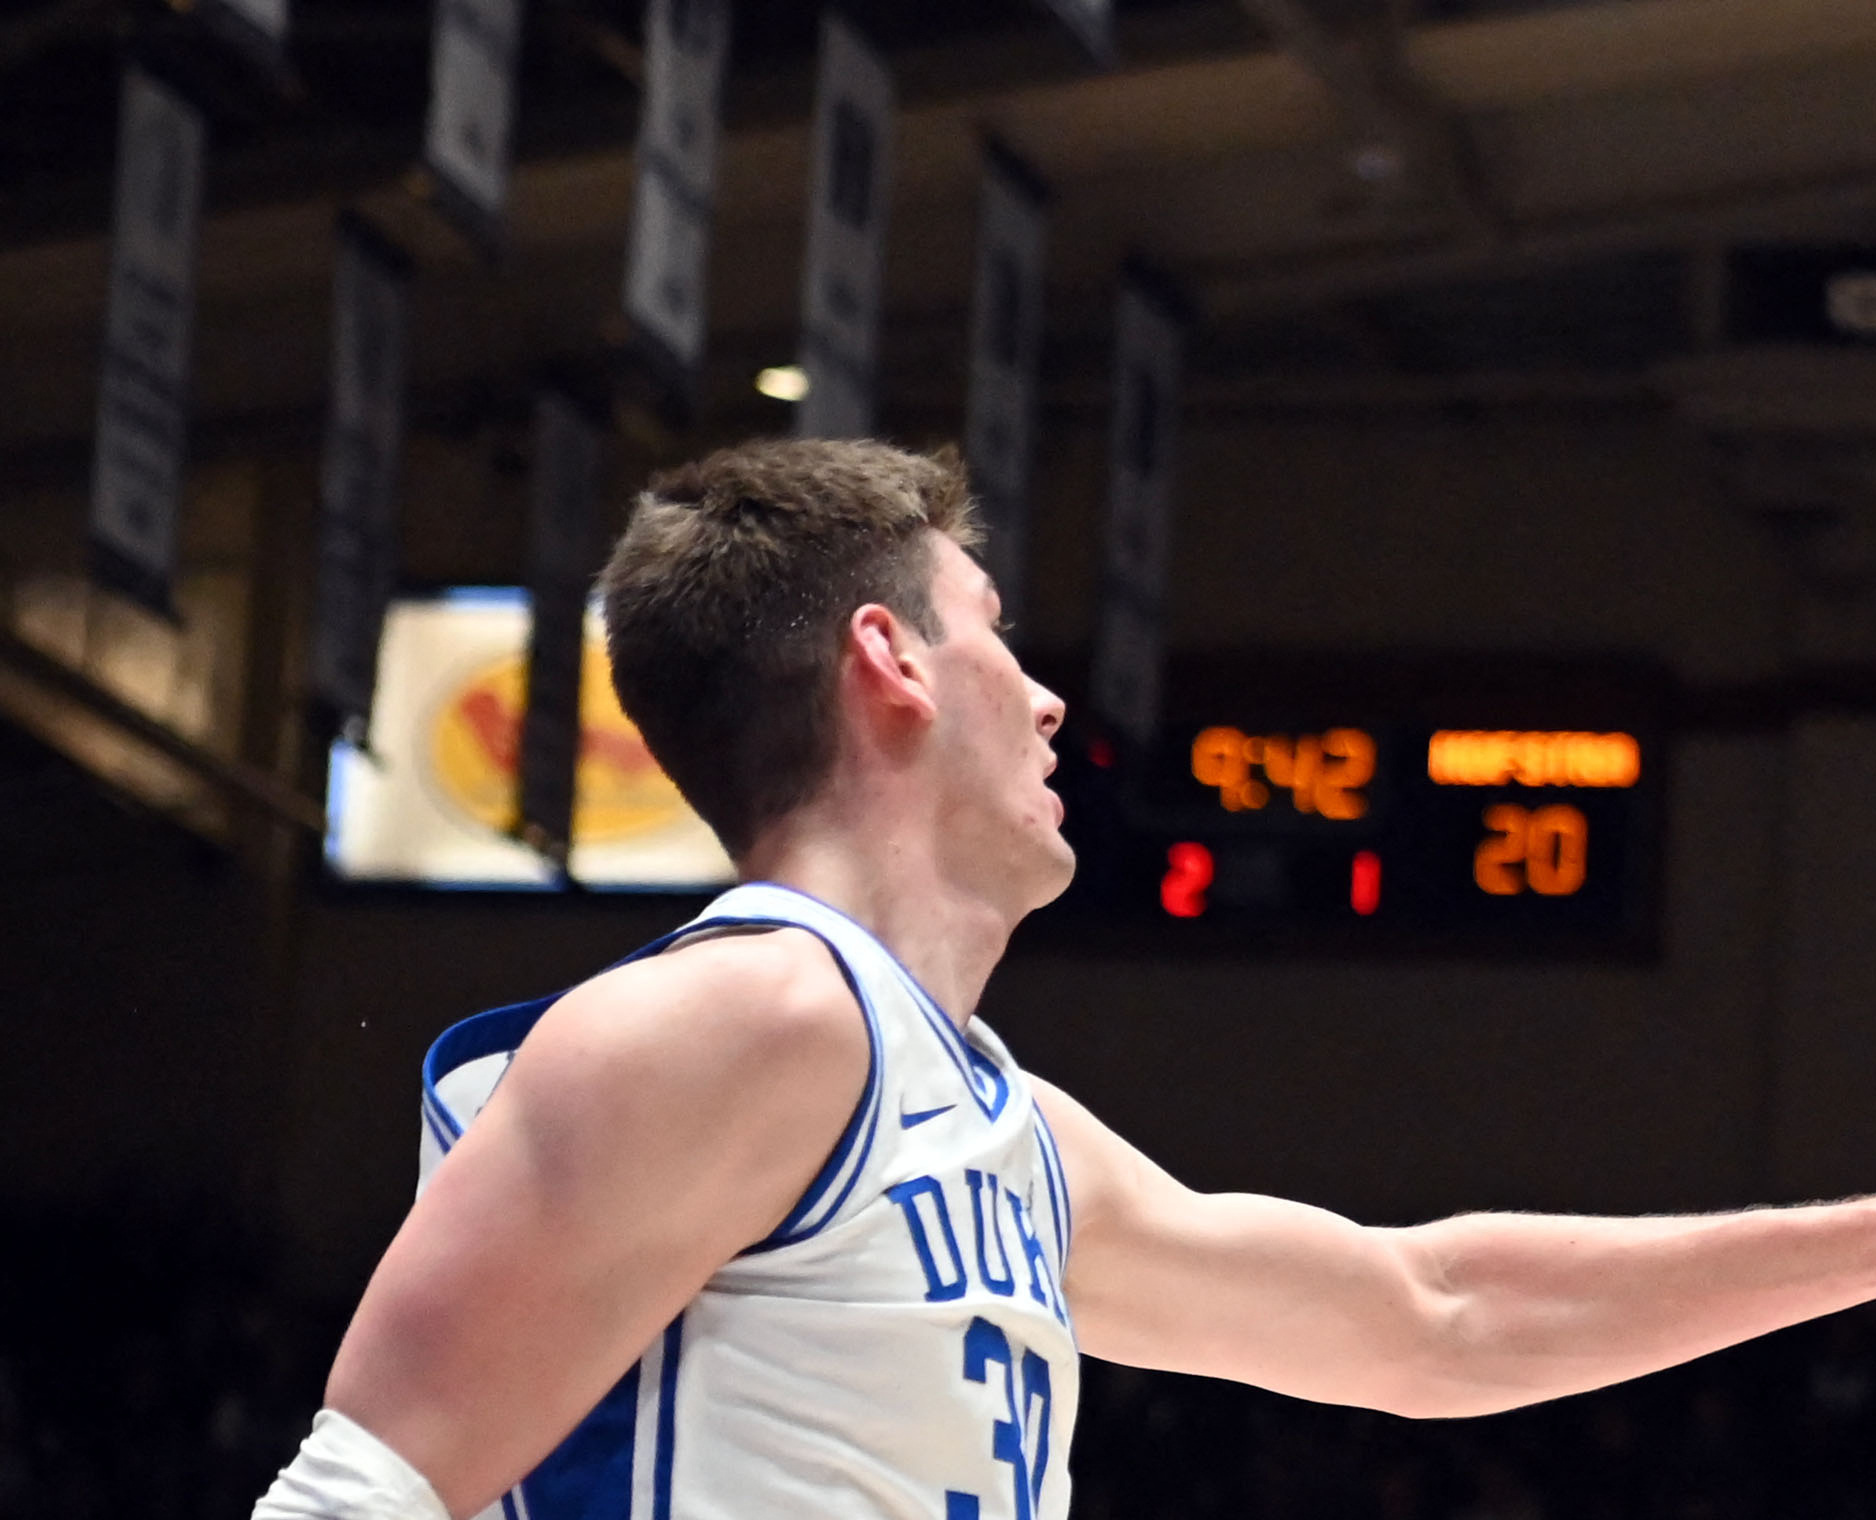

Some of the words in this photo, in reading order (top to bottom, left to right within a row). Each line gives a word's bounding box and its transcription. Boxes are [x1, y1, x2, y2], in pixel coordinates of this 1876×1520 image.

[1191, 725, 1377, 820] 9:42
[1474, 803, 1588, 895] 20
[883, 1168, 1066, 1327] DUK
